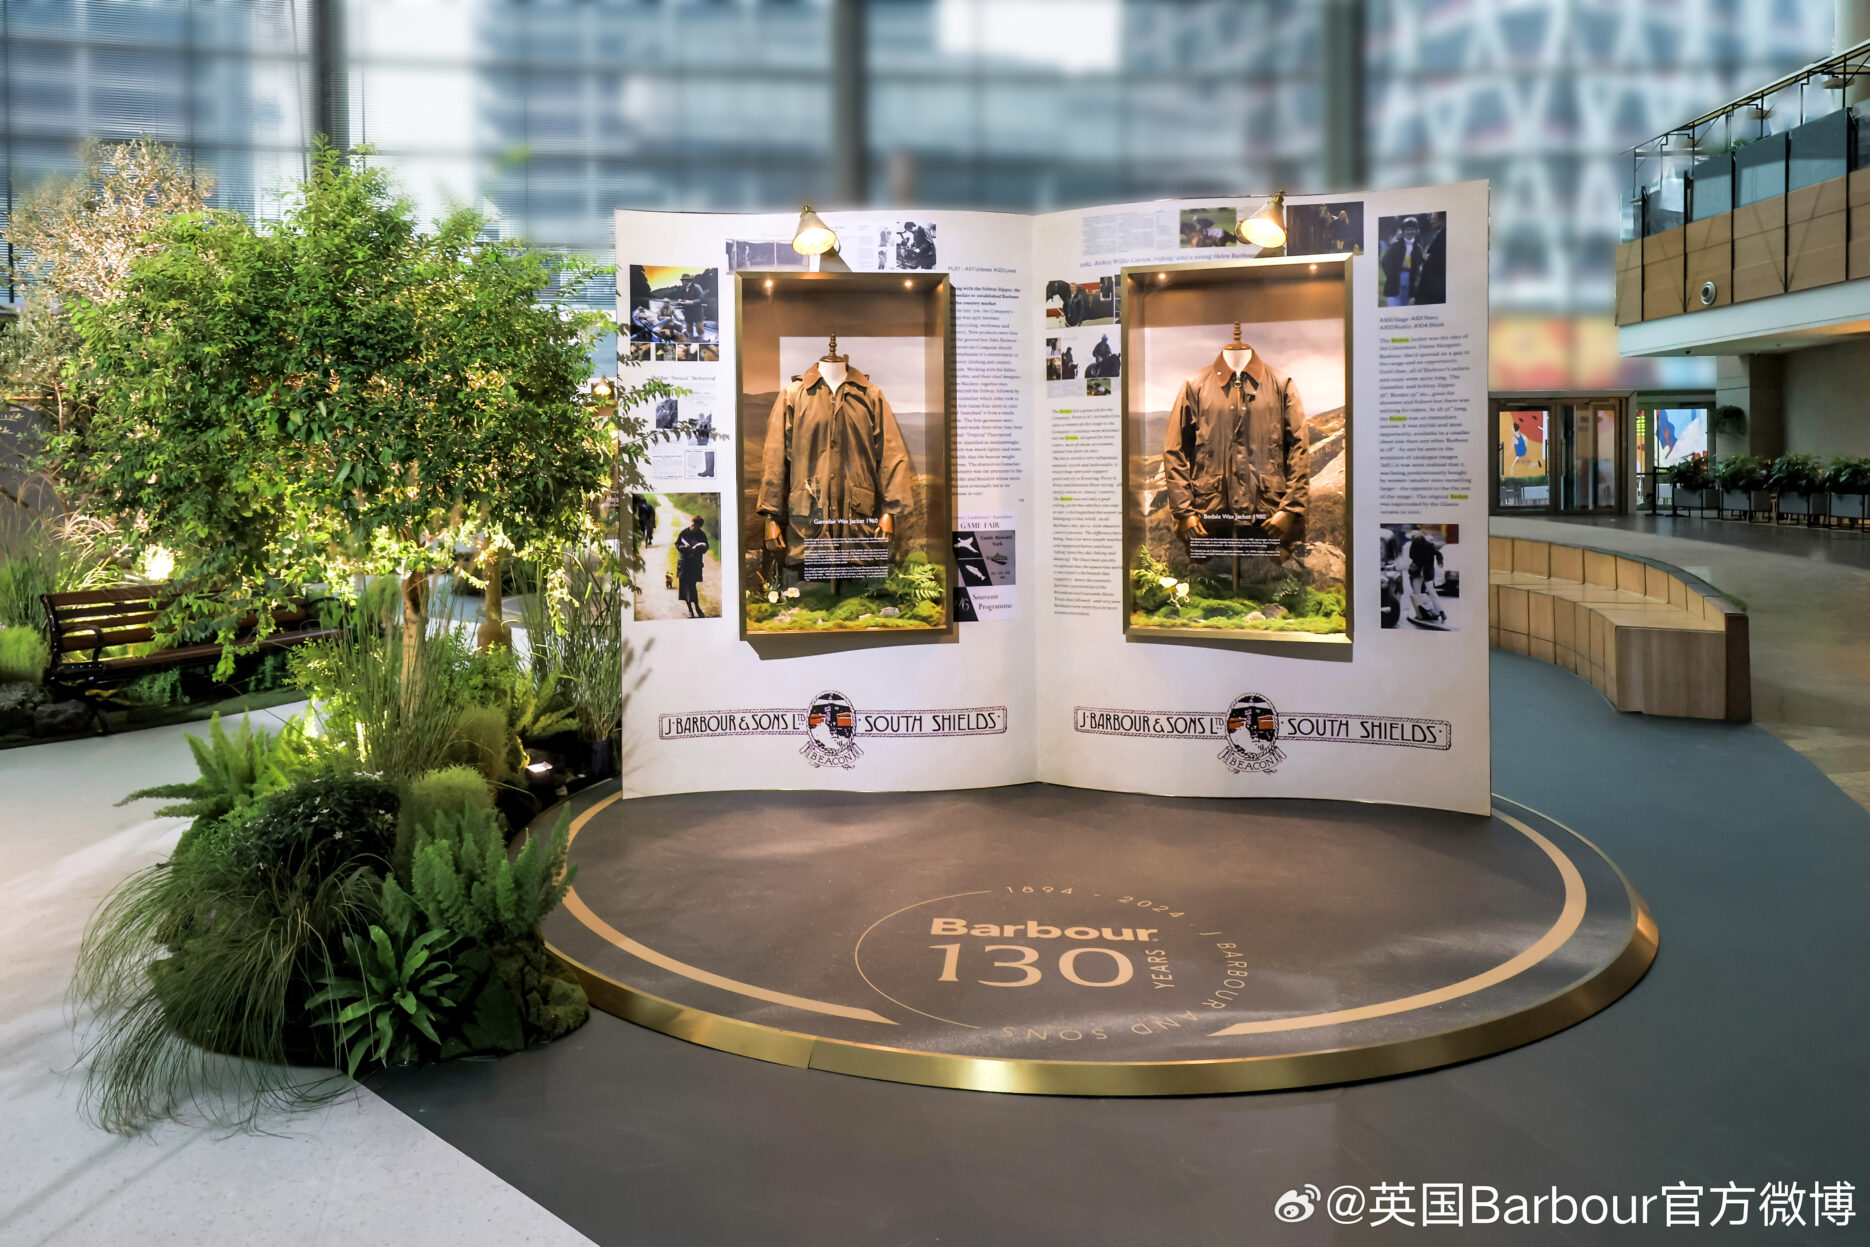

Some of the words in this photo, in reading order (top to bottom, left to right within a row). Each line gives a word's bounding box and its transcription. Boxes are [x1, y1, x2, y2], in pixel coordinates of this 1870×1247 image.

[978, 603, 1012, 612] Programme
[738, 718, 749, 731] &
[751, 713, 788, 731] SONS
[864, 714, 923, 733] SOUTH
[932, 712, 997, 732] SHIELDS
[1153, 719, 1164, 732] &
[1166, 717, 1205, 734] SONS
[1287, 718, 1348, 737] SOUTH
[1359, 721, 1438, 743] SHIELDS
[810, 752, 852, 766] BEACON
[1229, 757, 1274, 771] BEACON
[1006, 886, 1074, 895] 1894
[1118, 895, 1185, 919] 2024
[931, 918, 1159, 942] Barbour
[928, 943, 1133, 988] 130
[1145, 948, 1176, 990] YEARS
[1202, 942, 1248, 1009] BARBOUR
[1001, 1026, 1108, 1041] SONS
[1131, 1010, 1198, 1035] AND
